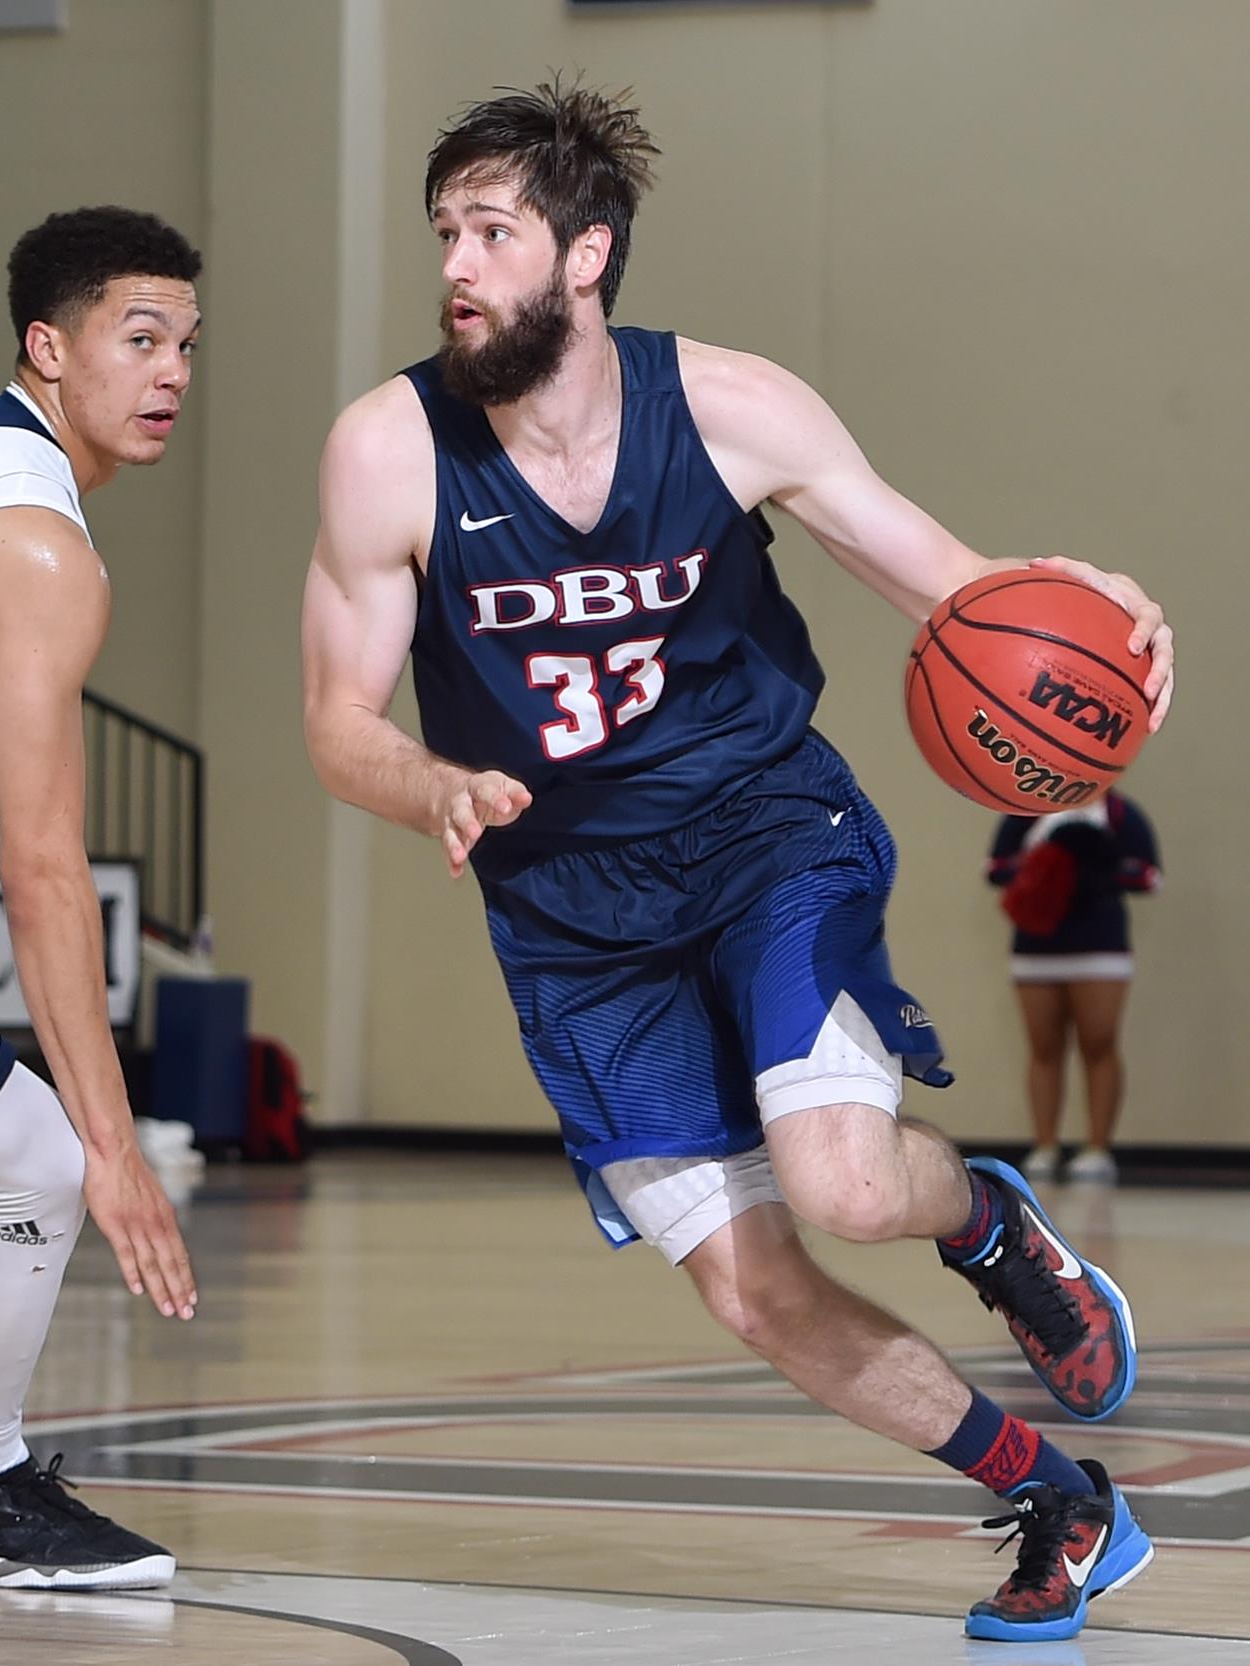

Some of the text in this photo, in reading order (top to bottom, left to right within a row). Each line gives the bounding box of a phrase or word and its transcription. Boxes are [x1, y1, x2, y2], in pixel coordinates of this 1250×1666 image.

[468, 549, 709, 635] DBU
[525, 635, 668, 762] 33
[1029, 671, 1132, 750] NCAA
[967, 709, 1098, 804] Wilson
